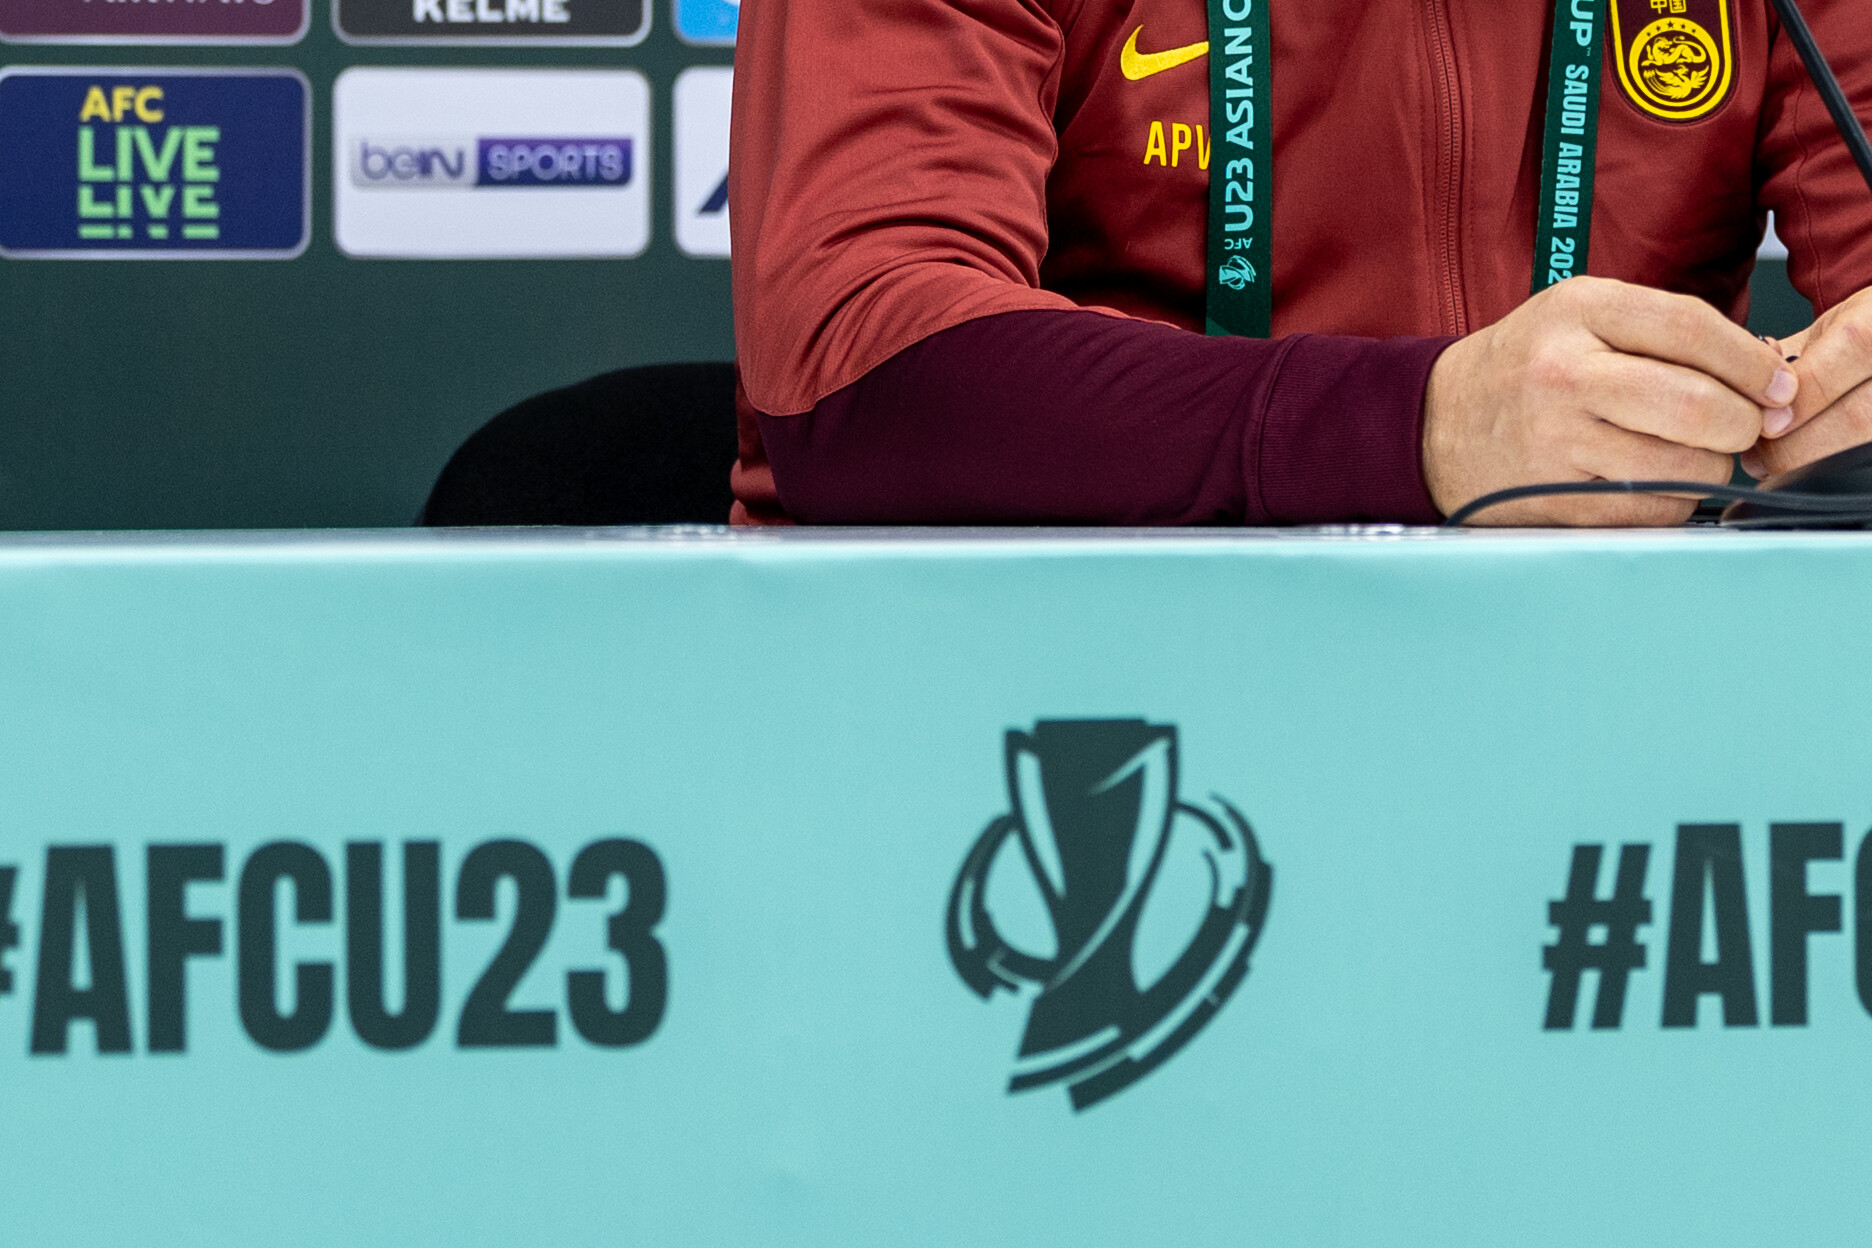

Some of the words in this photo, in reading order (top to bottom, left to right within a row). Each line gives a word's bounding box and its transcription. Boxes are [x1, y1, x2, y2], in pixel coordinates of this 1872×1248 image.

[80, 85, 164, 122] AFC
[1225, 27, 1254, 150] ASIAN
[1560, 64, 1590, 135] SAUDI
[78, 126, 220, 182] LIVE
[487, 142, 623, 180] SPORTS
[1552, 142, 1583, 229] ARABIA
[78, 185, 219, 238] LIVE
[1225, 156, 1255, 232] U23
[1548, 237, 1576, 285] 202
[0, 836, 672, 1058] AFCU23
